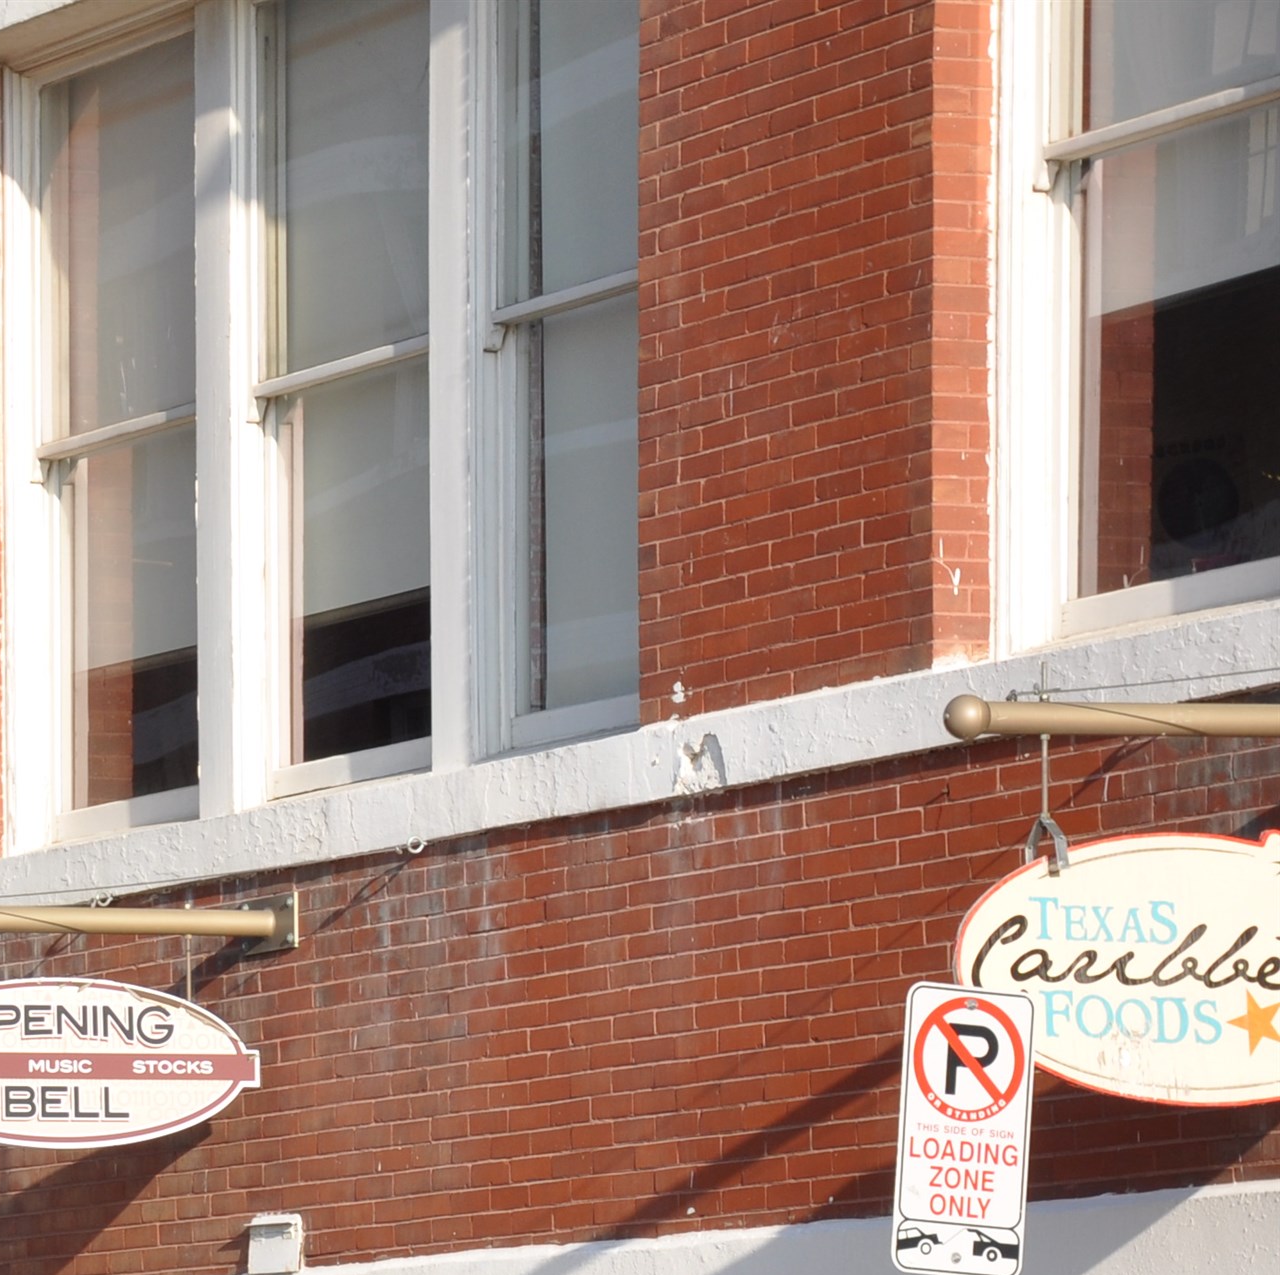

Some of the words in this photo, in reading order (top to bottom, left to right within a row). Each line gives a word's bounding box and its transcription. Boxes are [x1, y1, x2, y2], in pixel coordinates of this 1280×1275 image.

[1028, 896, 1178, 945] TEXAS
[1039, 989, 1223, 1045] FOODS
[28, 1058, 93, 1074] MUSIC
[132, 1059, 214, 1075] STOCKS
[3, 1085, 130, 1119] BELL
[926, 1091, 942, 1109] OR
[946, 1098, 1007, 1121] STANDING
[917, 1122, 940, 1133] THIS
[943, 1125, 967, 1136] SIDE
[971, 1128, 985, 1137] OF
[989, 1130, 1015, 1140] SIGN
[909, 1136, 1019, 1167] LOADING
[929, 1166, 995, 1192] ZONE
[929, 1193, 991, 1219] ONLY
